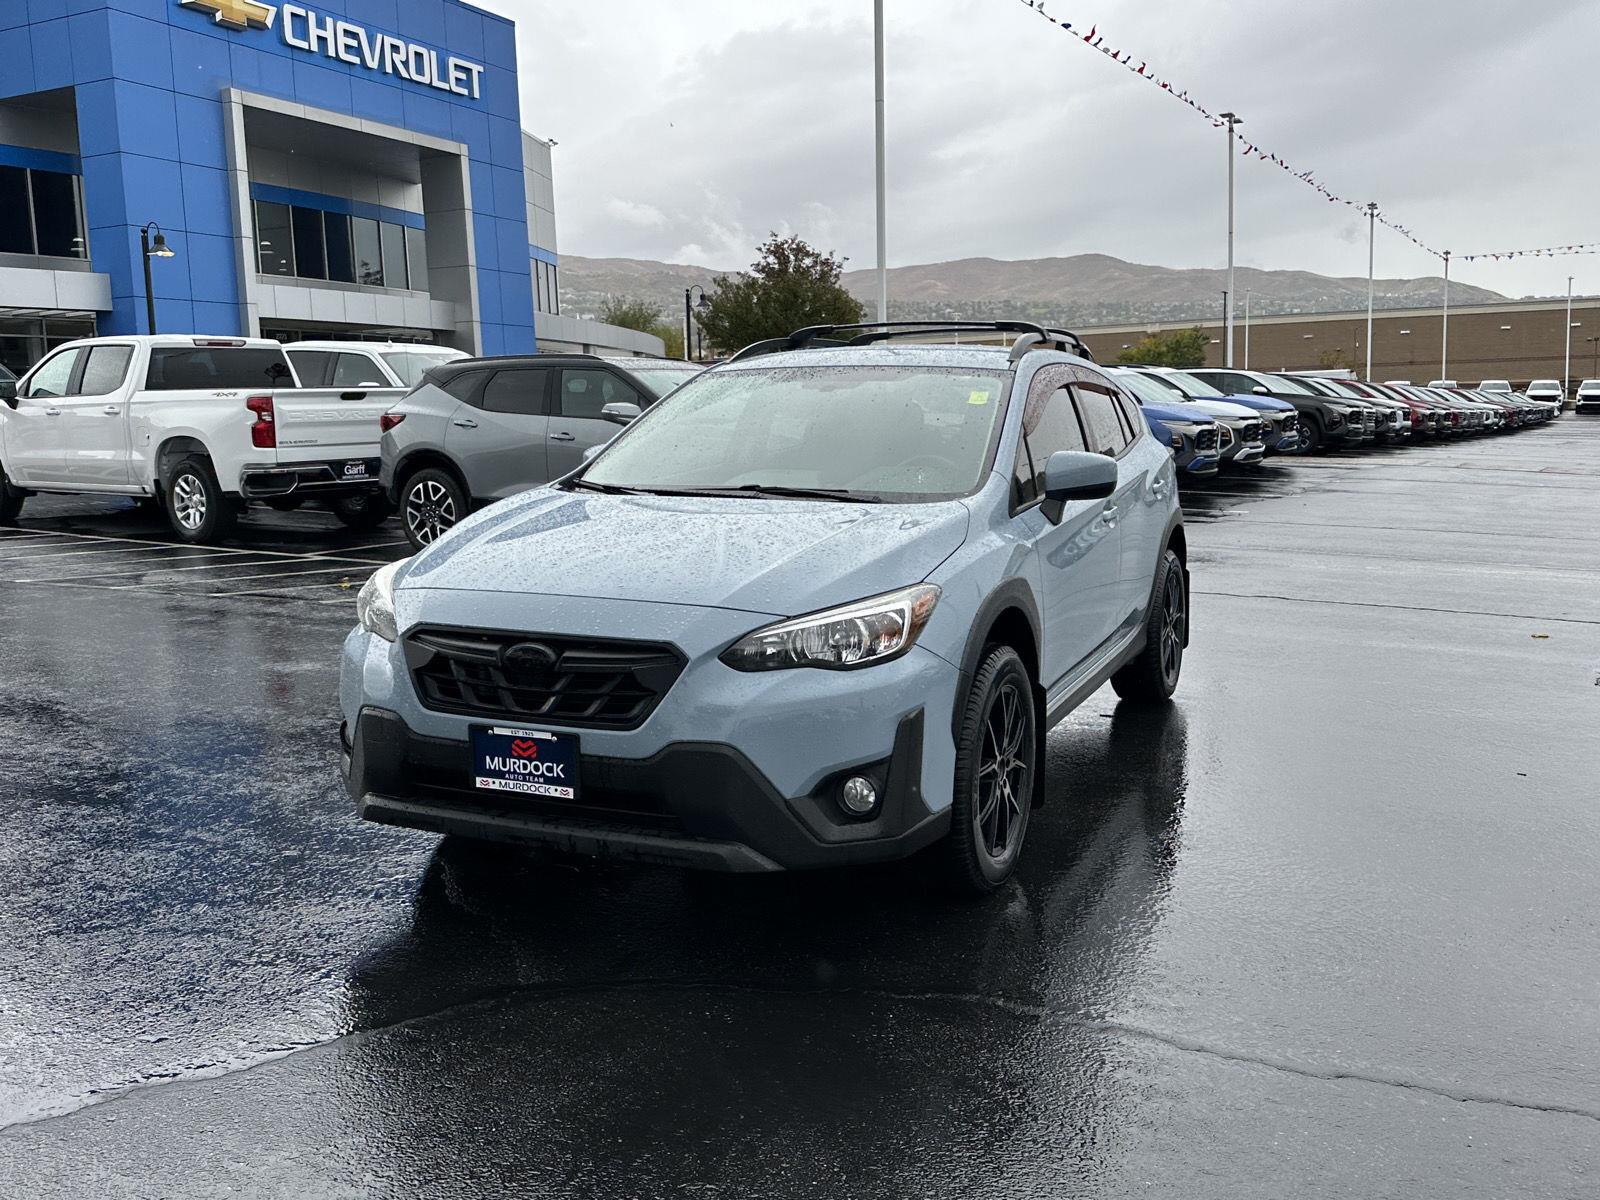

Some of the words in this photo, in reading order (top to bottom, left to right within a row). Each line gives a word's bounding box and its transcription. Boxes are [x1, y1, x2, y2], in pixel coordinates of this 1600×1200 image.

[282, 3, 484, 99] CHEVROLET
[344, 464, 366, 475] Garff
[485, 755, 565, 778] MURDOCK
[505, 773, 523, 781] AUTO
[526, 775, 544, 783] TEAM
[498, 780, 552, 795] MURDOCK
